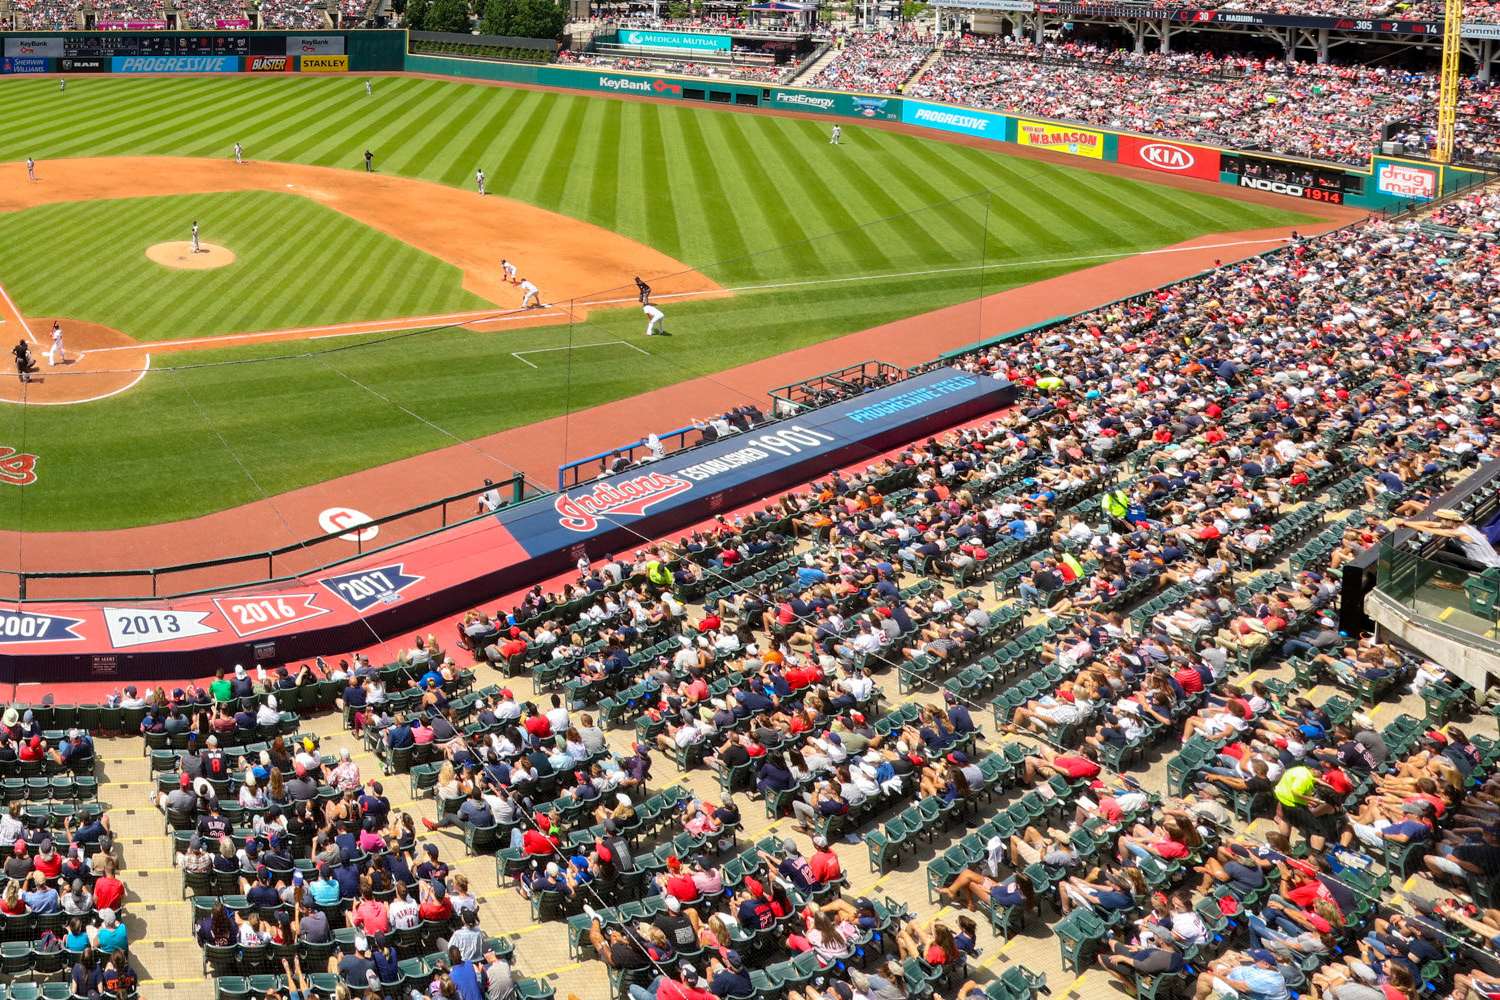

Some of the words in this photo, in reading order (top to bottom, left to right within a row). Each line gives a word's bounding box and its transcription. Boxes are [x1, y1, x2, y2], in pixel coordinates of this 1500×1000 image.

[1199, 11, 1209, 21] 30
[1226, 14, 1253, 23] NAQUIN
[1353, 20, 1372, 30] .305
[1391, 22, 1398, 32] 2
[1425, 23, 1437, 34] 14
[645, 34, 681, 44] MEDICAL
[683, 37, 718, 46] MUTUAL
[14, 58, 44, 66] SHERWIN
[121, 58, 227, 72] PROGRESSIVE
[252, 58, 287, 70] BLASTER
[303, 59, 345, 68] STANLEY
[599, 76, 651, 91] KeyBank
[776, 92, 834, 107] FirstEnergy
[915, 108, 989, 131] PROGRESSIVE
[1149, 147, 1185, 166] KIA
[1382, 164, 1424, 186] drug
[1241, 176, 1303, 197] NOCO
[1304, 188, 1340, 204] 1914
[1385, 182, 1434, 198] mart
[845, 388, 942, 424] PROGRESSIVE
[932, 376, 977, 394] FIELD
[555, 472, 693, 532] Indians
[678, 446, 769, 481] ESTABLISHED
[748, 425, 835, 456] 1901
[338, 571, 392, 601] 2017
[232, 599, 296, 625] 2016
[118, 614, 181, 635] 2013
